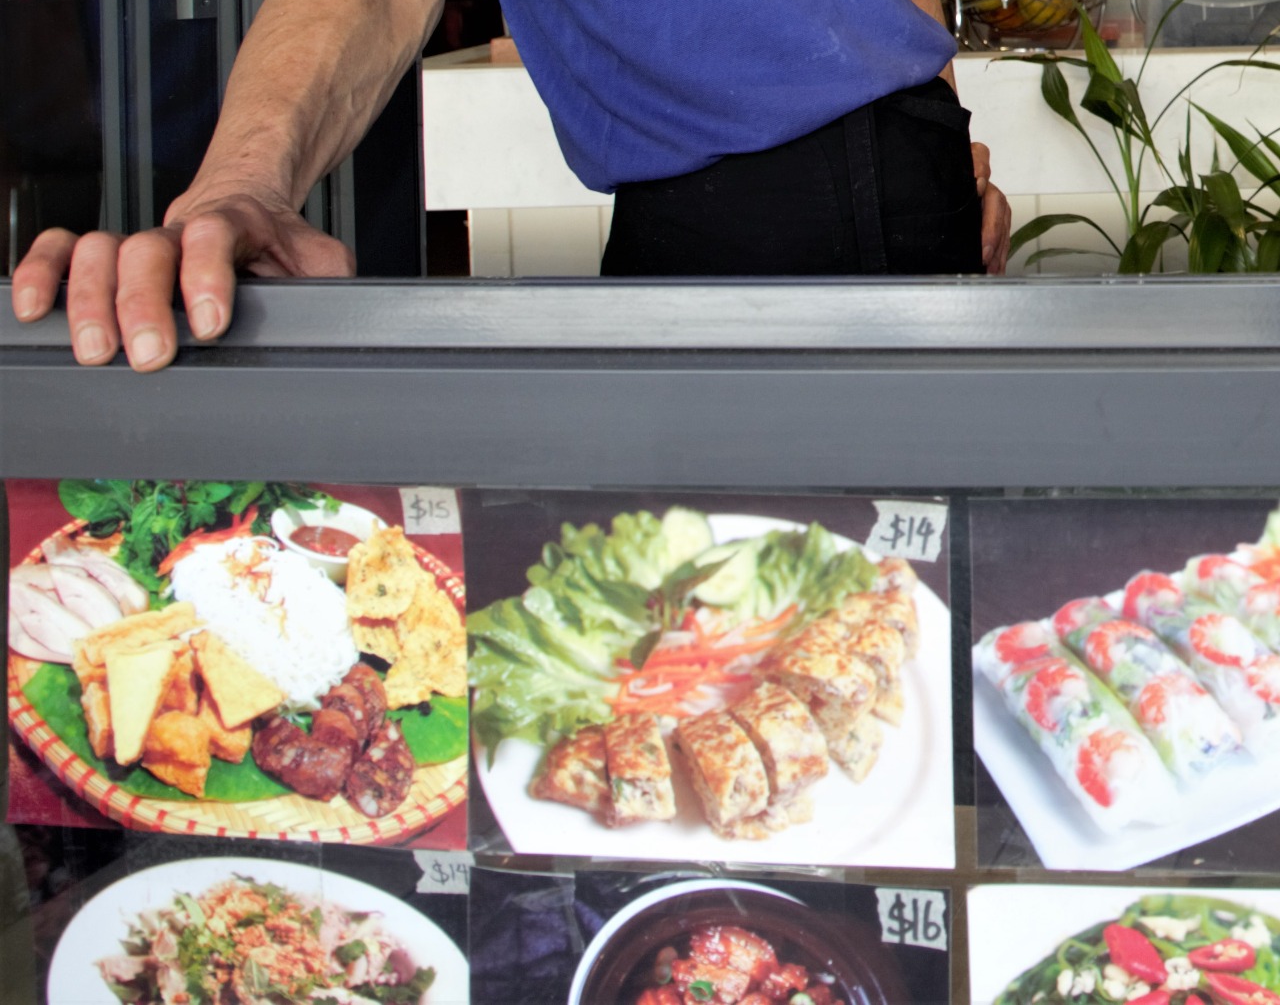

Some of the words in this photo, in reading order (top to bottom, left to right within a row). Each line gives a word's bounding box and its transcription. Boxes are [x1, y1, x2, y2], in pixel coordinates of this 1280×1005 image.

[407, 494, 451, 522] $15
[880, 513, 935, 555] $14
[430, 859, 469, 886] $14
[887, 893, 942, 946] $16
